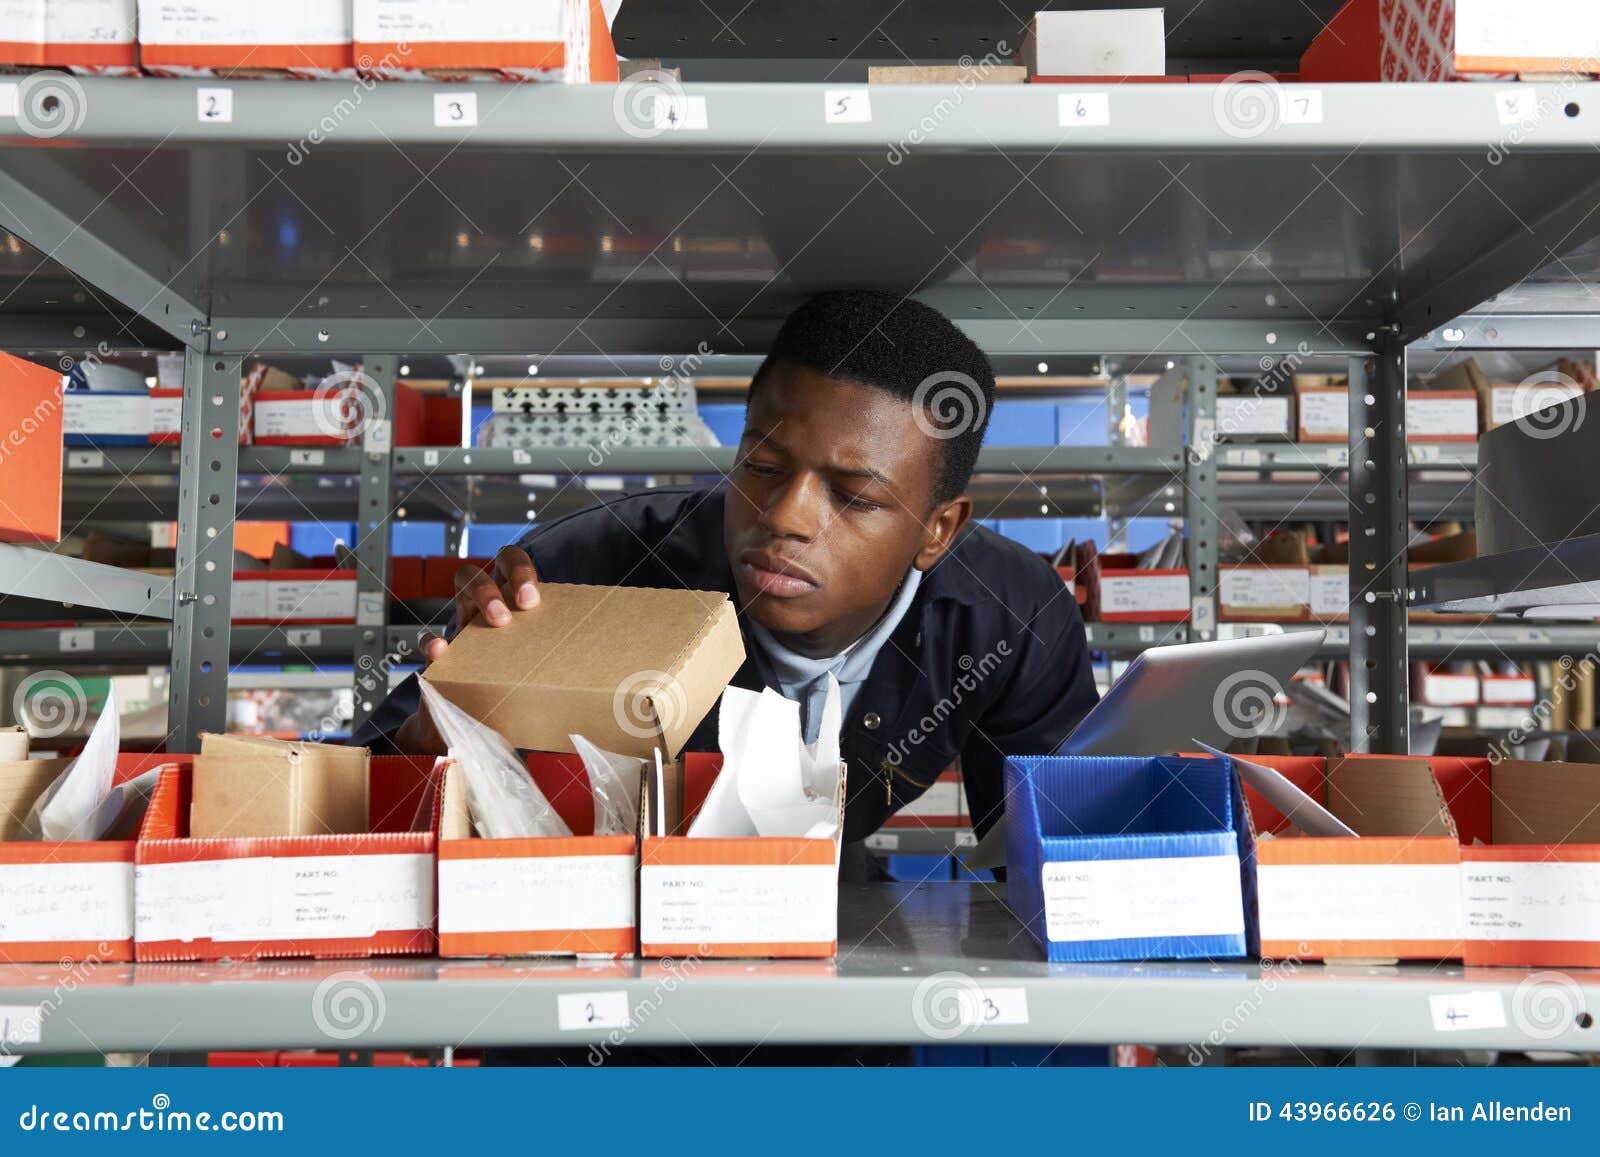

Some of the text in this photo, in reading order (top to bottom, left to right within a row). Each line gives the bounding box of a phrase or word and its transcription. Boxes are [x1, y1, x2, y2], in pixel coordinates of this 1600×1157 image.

[205, 96, 220, 117] 2
[448, 102, 464, 121] 3
[667, 104, 678, 125] 4
[833, 96, 851, 116] 5
[1075, 98, 1087, 118] 6
[1293, 98, 1309, 116] 7
[585, 1001, 604, 1023] 2
[982, 998, 999, 1021] 3
